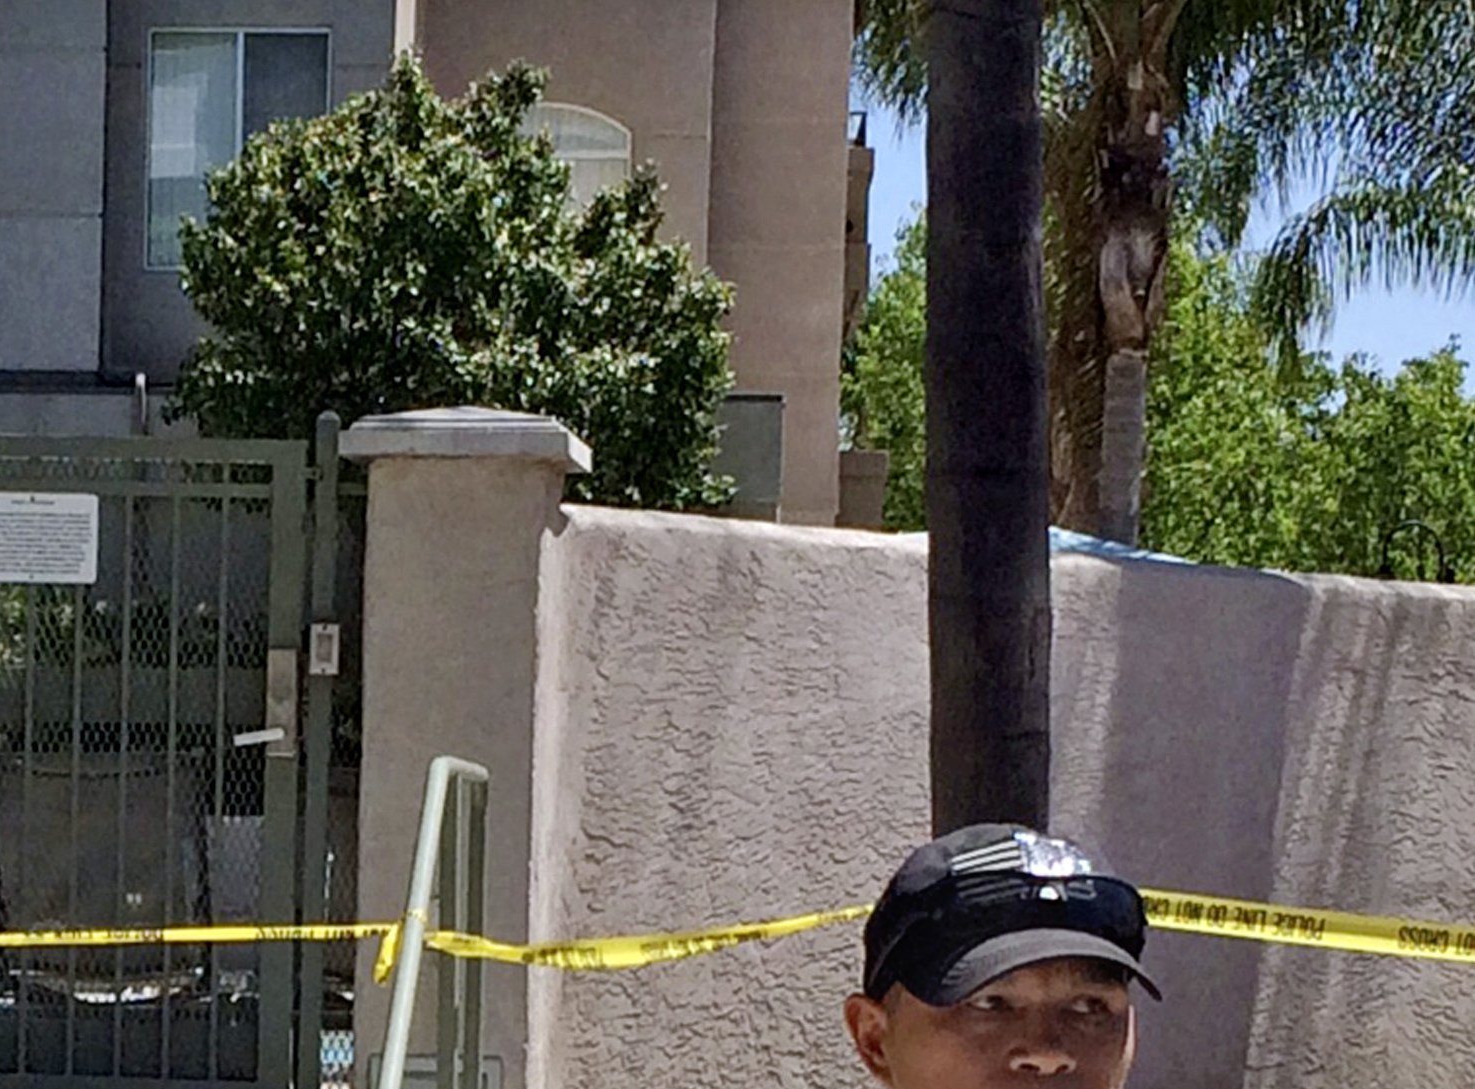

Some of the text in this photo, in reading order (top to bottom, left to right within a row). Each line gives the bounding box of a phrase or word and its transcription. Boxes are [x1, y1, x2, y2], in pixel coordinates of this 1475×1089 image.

[1174, 899, 1203, 925] NOT
[1206, 904, 1228, 928] DO
[1234, 907, 1268, 933] LINE
[1271, 912, 1327, 940] POLICE
